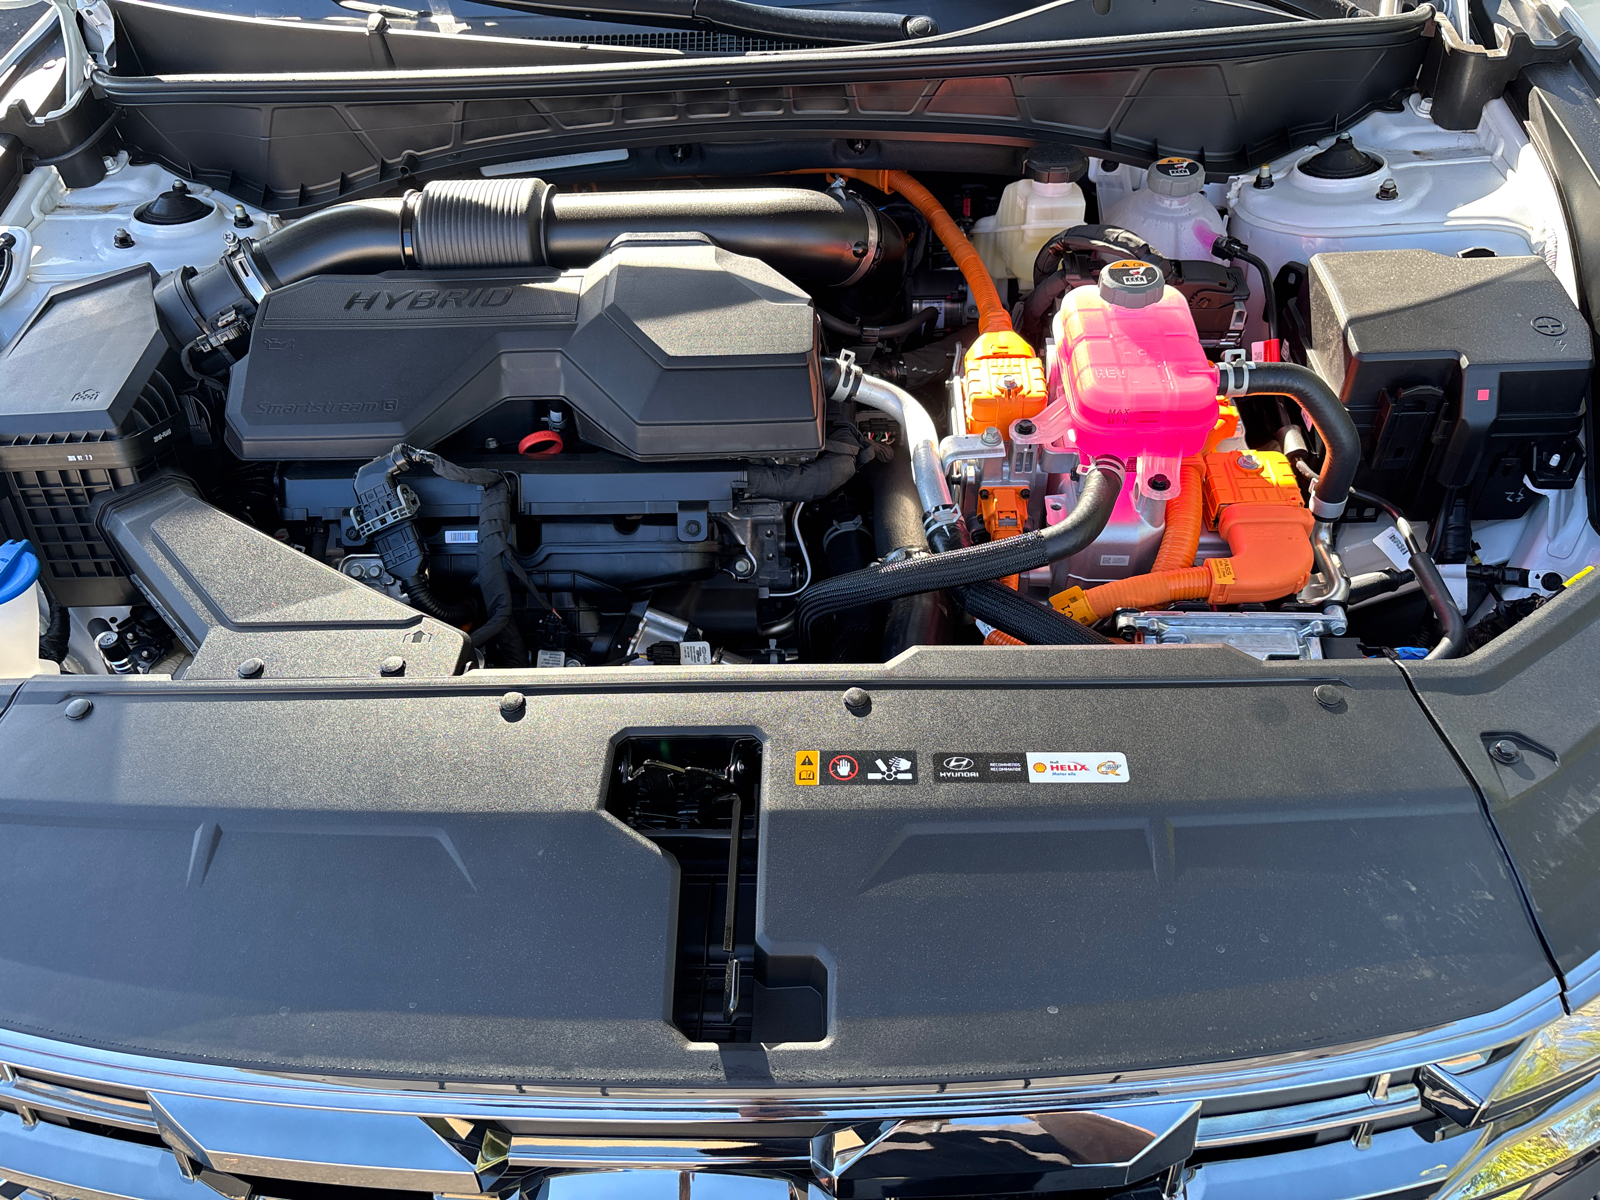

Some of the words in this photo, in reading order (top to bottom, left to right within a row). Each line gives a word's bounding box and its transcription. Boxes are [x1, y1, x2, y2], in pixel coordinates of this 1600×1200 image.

[342, 286, 514, 311] HYBRID
[254, 400, 378, 414] Smartstream
[1108, 408, 1130, 416] MAX
[1050, 764, 1090, 772] HELIX
